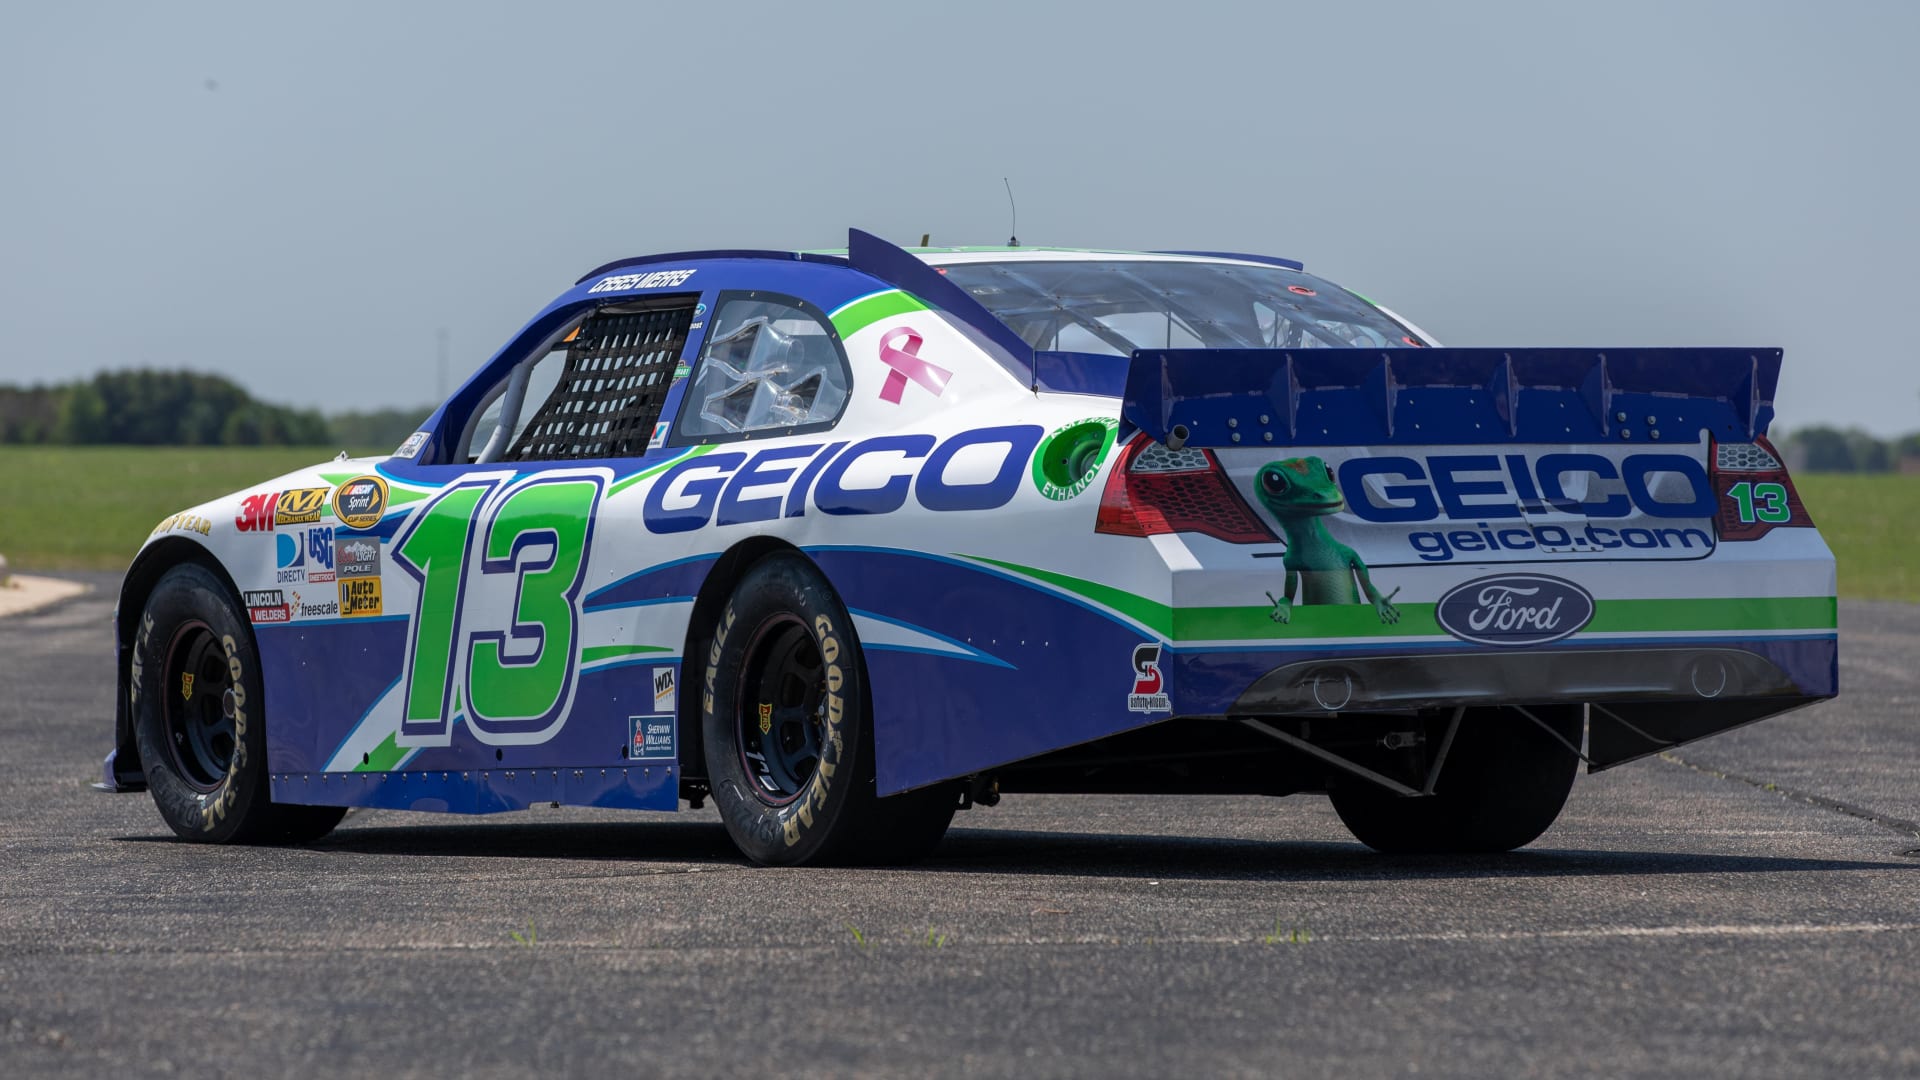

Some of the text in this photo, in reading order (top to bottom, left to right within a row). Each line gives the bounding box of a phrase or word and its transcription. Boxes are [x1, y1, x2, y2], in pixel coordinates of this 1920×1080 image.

[643, 425, 1044, 534] GEICO
[1042, 462, 1103, 500] ETHANOL
[1338, 453, 1718, 523] GEICO
[235, 492, 280, 532] 3M
[347, 495, 370, 511] Sprint
[1727, 481, 1791, 524] 13
[308, 527, 333, 569] USG
[1408, 522, 1712, 561] geico.com
[277, 569, 305, 583] DIRECTV
[344, 565, 371, 574] POLE
[245, 591, 281, 606] LINCOLN
[351, 581, 374, 595] Auto
[351, 595, 380, 610] Meter
[254, 604, 286, 621] WELDERS
[301, 600, 338, 616] freescale
[390, 472, 605, 738] 13
[1469, 585, 1563, 631] Ford
[703, 598, 736, 715] EAGLE
[655, 669, 674, 693] WIX
[645, 735, 671, 745] WILLIAMS
[647, 723, 670, 735] SHERWIN
[783, 614, 844, 848] GOODYEAR
